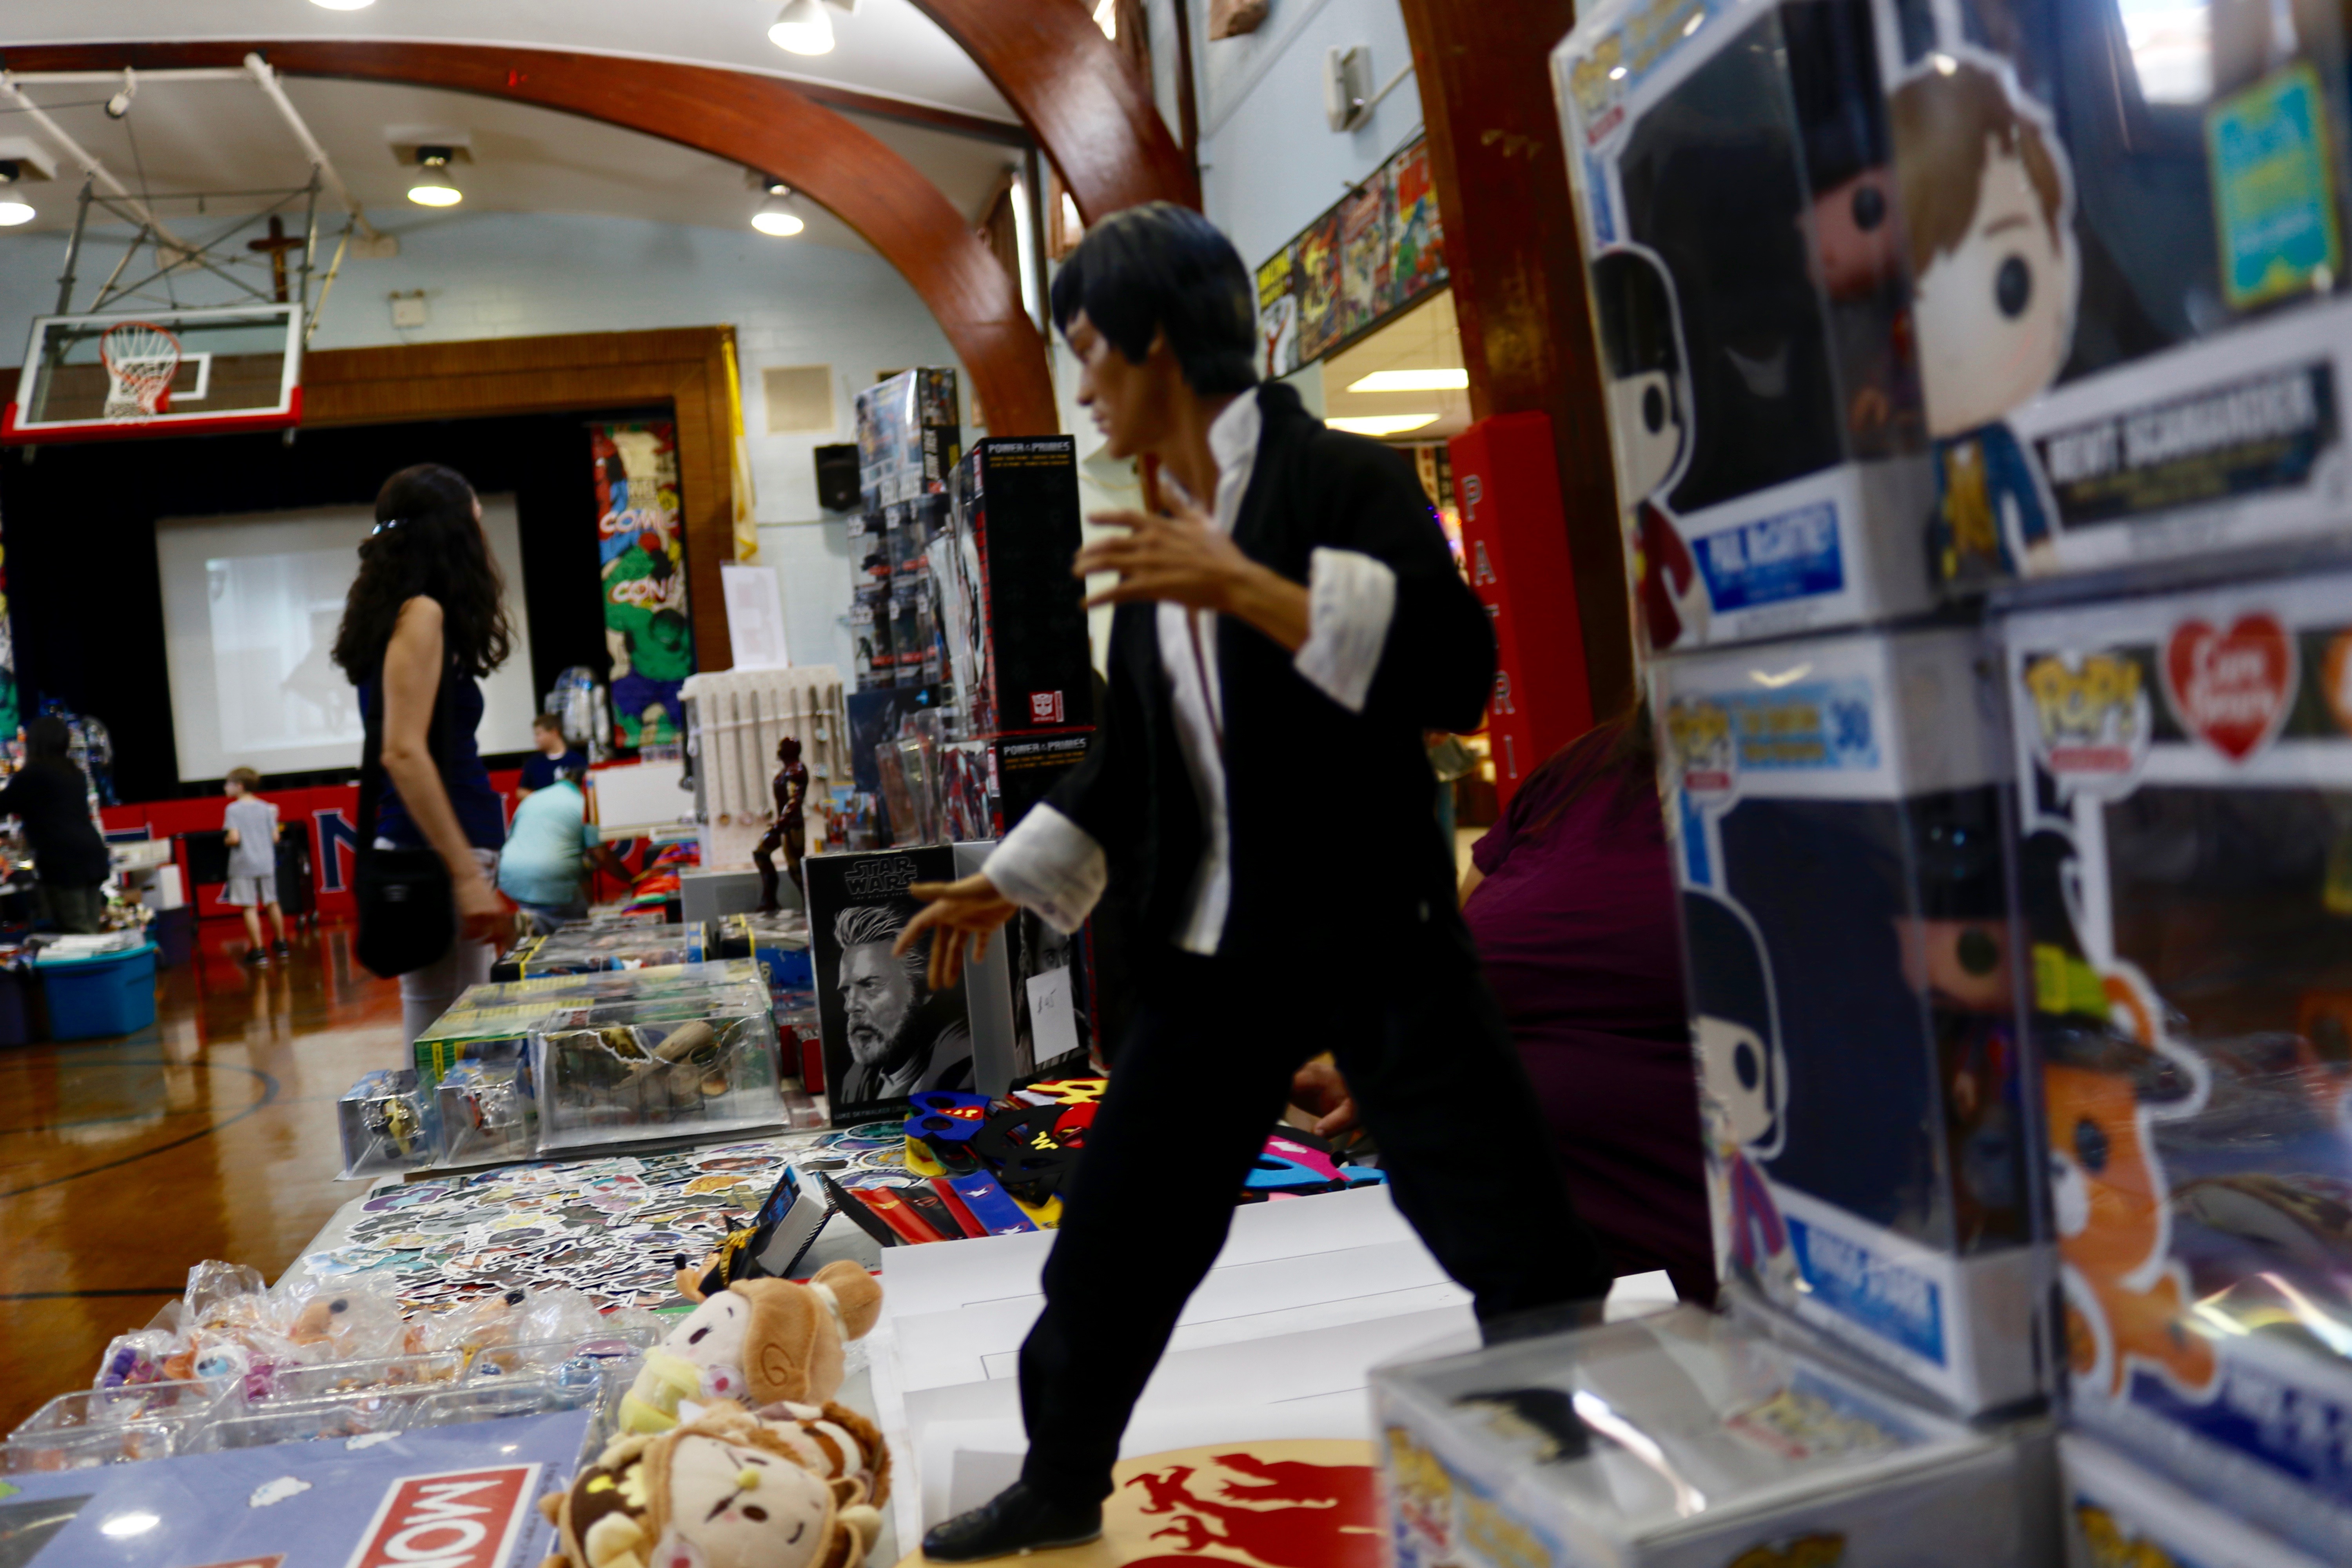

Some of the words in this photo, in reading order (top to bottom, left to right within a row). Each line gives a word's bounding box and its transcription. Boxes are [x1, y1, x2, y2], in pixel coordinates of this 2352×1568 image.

[599, 508, 679, 534] COMIC
[844, 856, 917, 878] STAR
[845, 872, 918, 895] WARS
